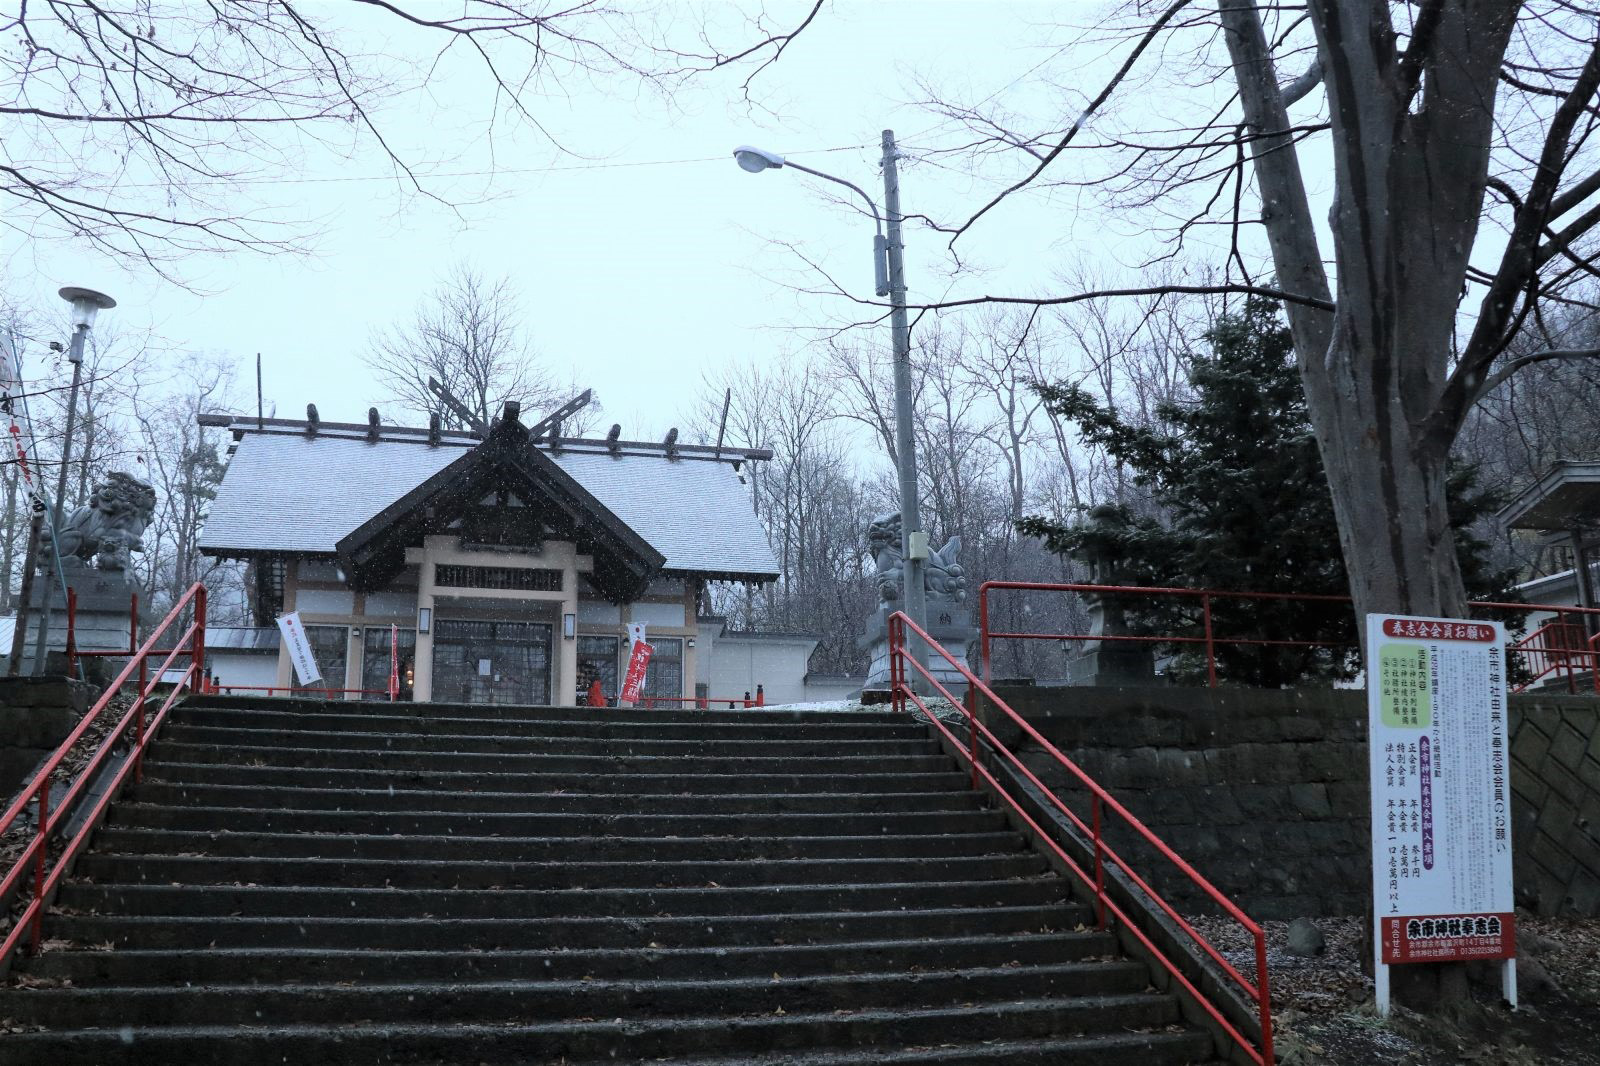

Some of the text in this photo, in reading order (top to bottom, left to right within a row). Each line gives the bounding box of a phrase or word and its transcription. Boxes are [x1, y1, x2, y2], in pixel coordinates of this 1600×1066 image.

[1392, 621, 1490, 639] 奉志会会員お願い
[1385, 742, 1395, 787] 法人会員
[1396, 742, 1406, 787] 特別会員
[1408, 742, 1417, 776] 正会員
[1391, 919, 1401, 958] 問合せ先
[1406, 916, 1502, 939] 余市神社奉志会
